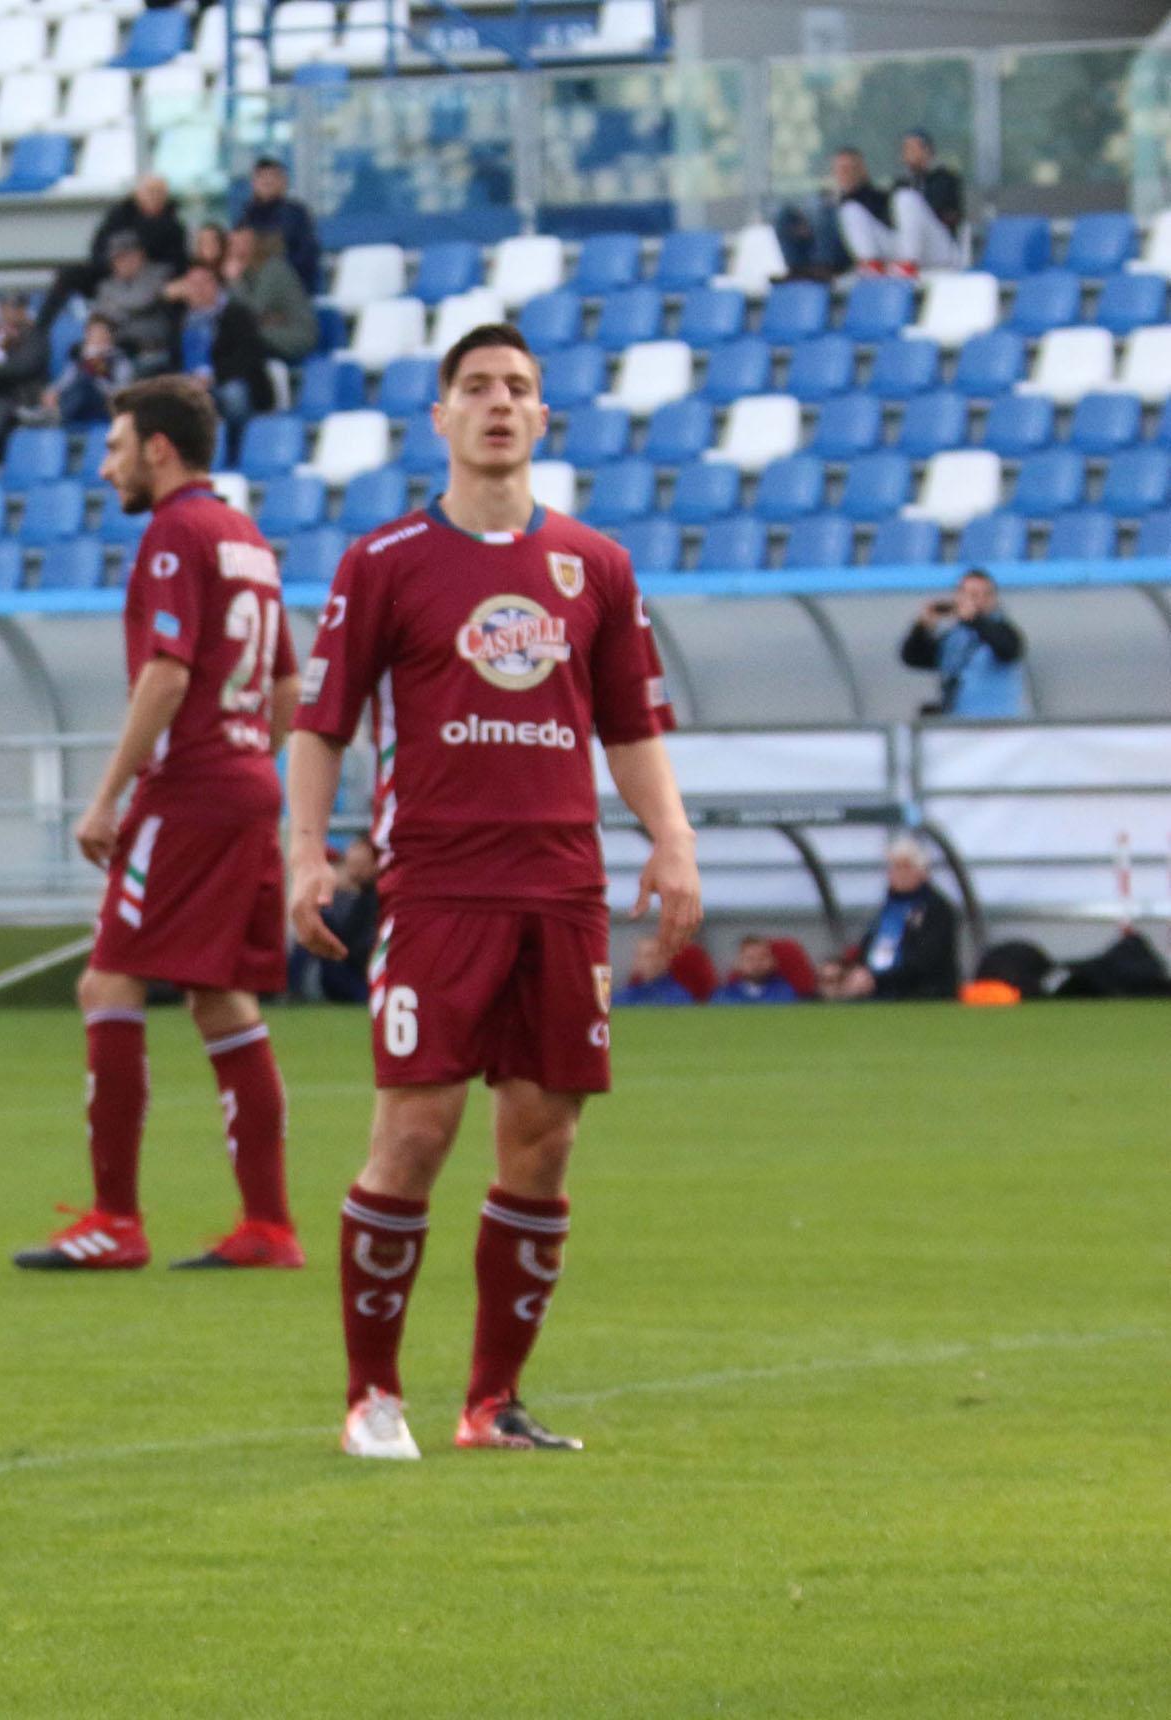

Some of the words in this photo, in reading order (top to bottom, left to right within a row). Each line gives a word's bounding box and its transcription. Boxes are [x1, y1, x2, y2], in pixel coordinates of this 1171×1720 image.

[456, 617, 566, 662] CASTELLI
[440, 713, 576, 750] olmedo
[386, 986, 419, 1057] 6
